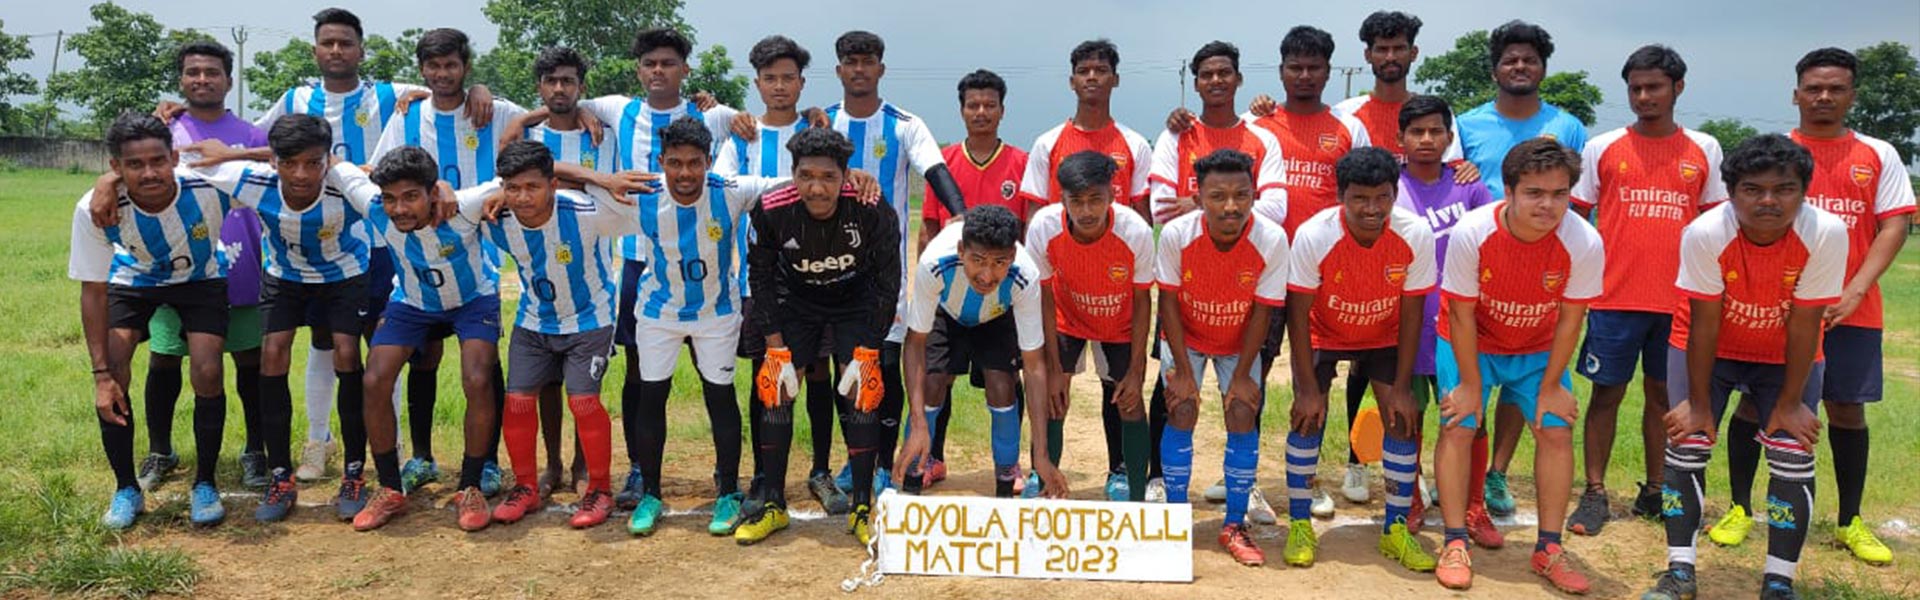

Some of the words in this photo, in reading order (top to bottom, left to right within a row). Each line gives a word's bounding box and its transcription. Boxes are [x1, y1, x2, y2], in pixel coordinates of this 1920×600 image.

[677, 259, 708, 282] 10
[792, 254, 855, 272] Jeep
[882, 502, 1009, 539] LOYOLA
[1018, 506, 1189, 542] FOOTBALL
[904, 539, 1020, 575] MATCH
[1045, 544, 1119, 573] 2023
